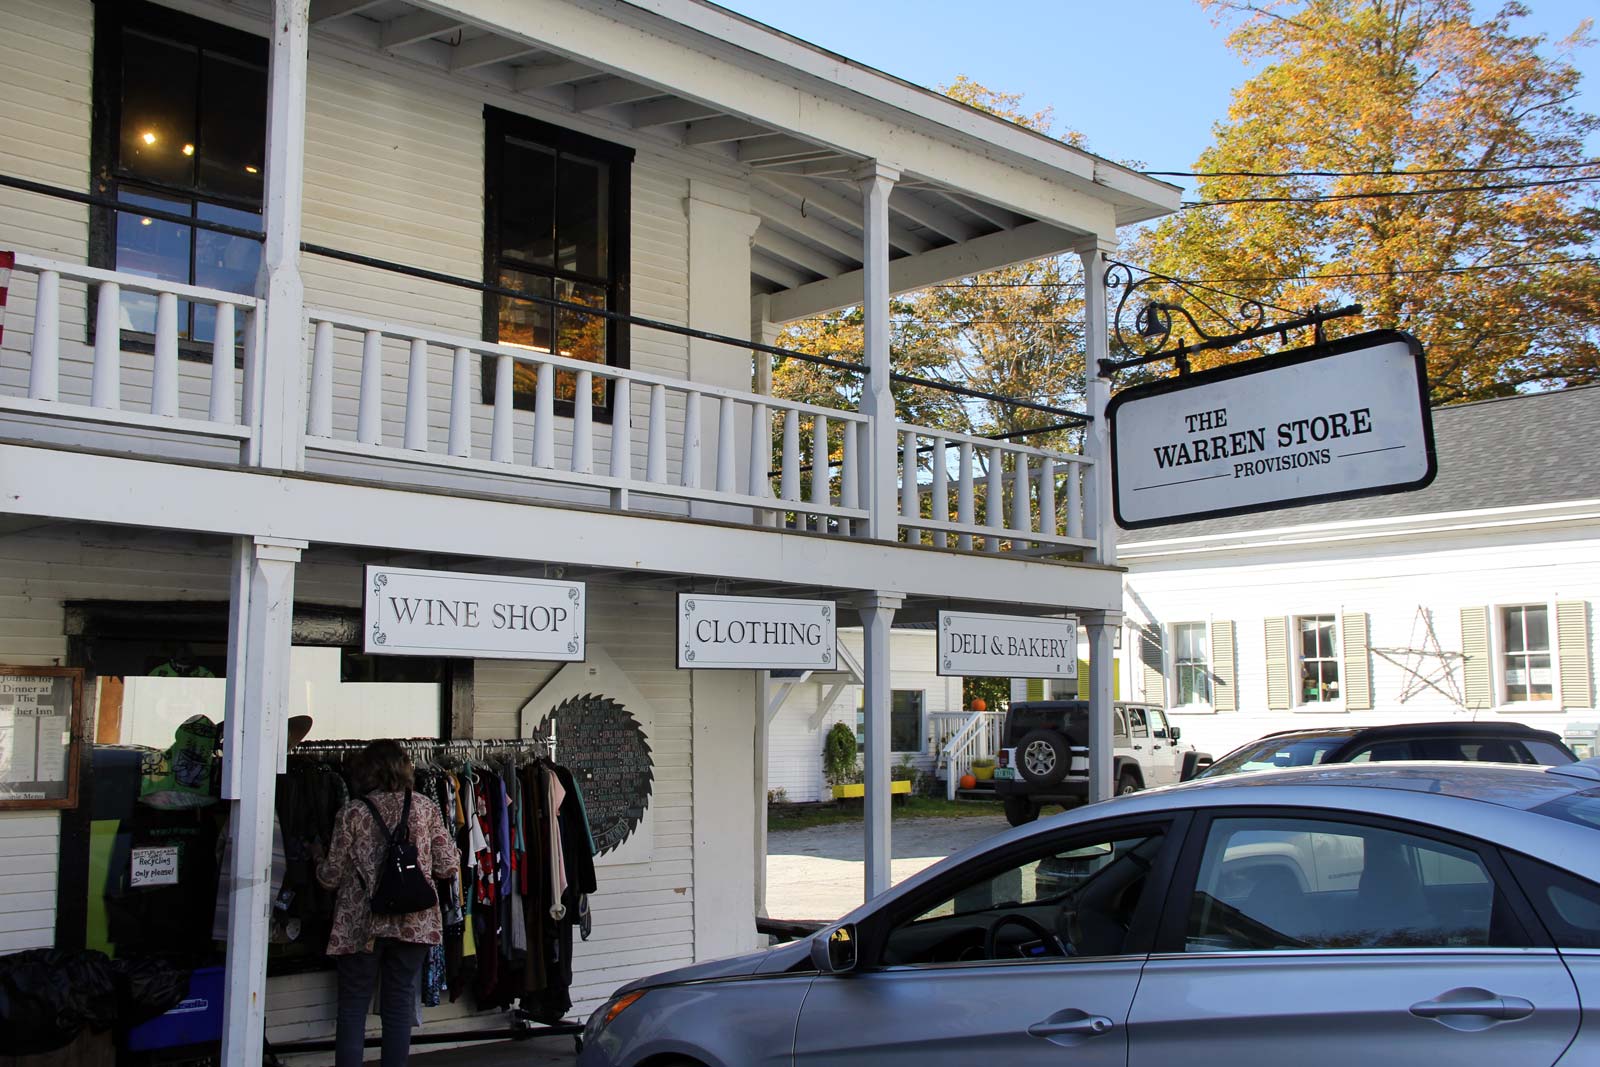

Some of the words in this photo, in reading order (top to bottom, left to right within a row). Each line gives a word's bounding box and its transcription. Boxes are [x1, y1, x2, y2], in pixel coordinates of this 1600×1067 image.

[1185, 408, 1228, 433] THE
[1153, 427, 1266, 469] WARREN
[1277, 407, 1373, 448] STORE
[1233, 448, 1331, 479] PROVISIONS
[388, 596, 480, 628] WINE
[491, 603, 568, 632] SHOP
[695, 619, 822, 646] CLOTHING
[950, 632, 988, 655] DELI
[990, 635, 1005, 656] &
[1007, 636, 1069, 658] BAKERY
[2, 684, 37, 693] Dinner
[16, 694, 36, 703] The
[35, 707, 53, 715] Inn
[135, 867, 150, 879] only
[150, 867, 175, 878] please!
[139, 857, 171, 867] Recycling
